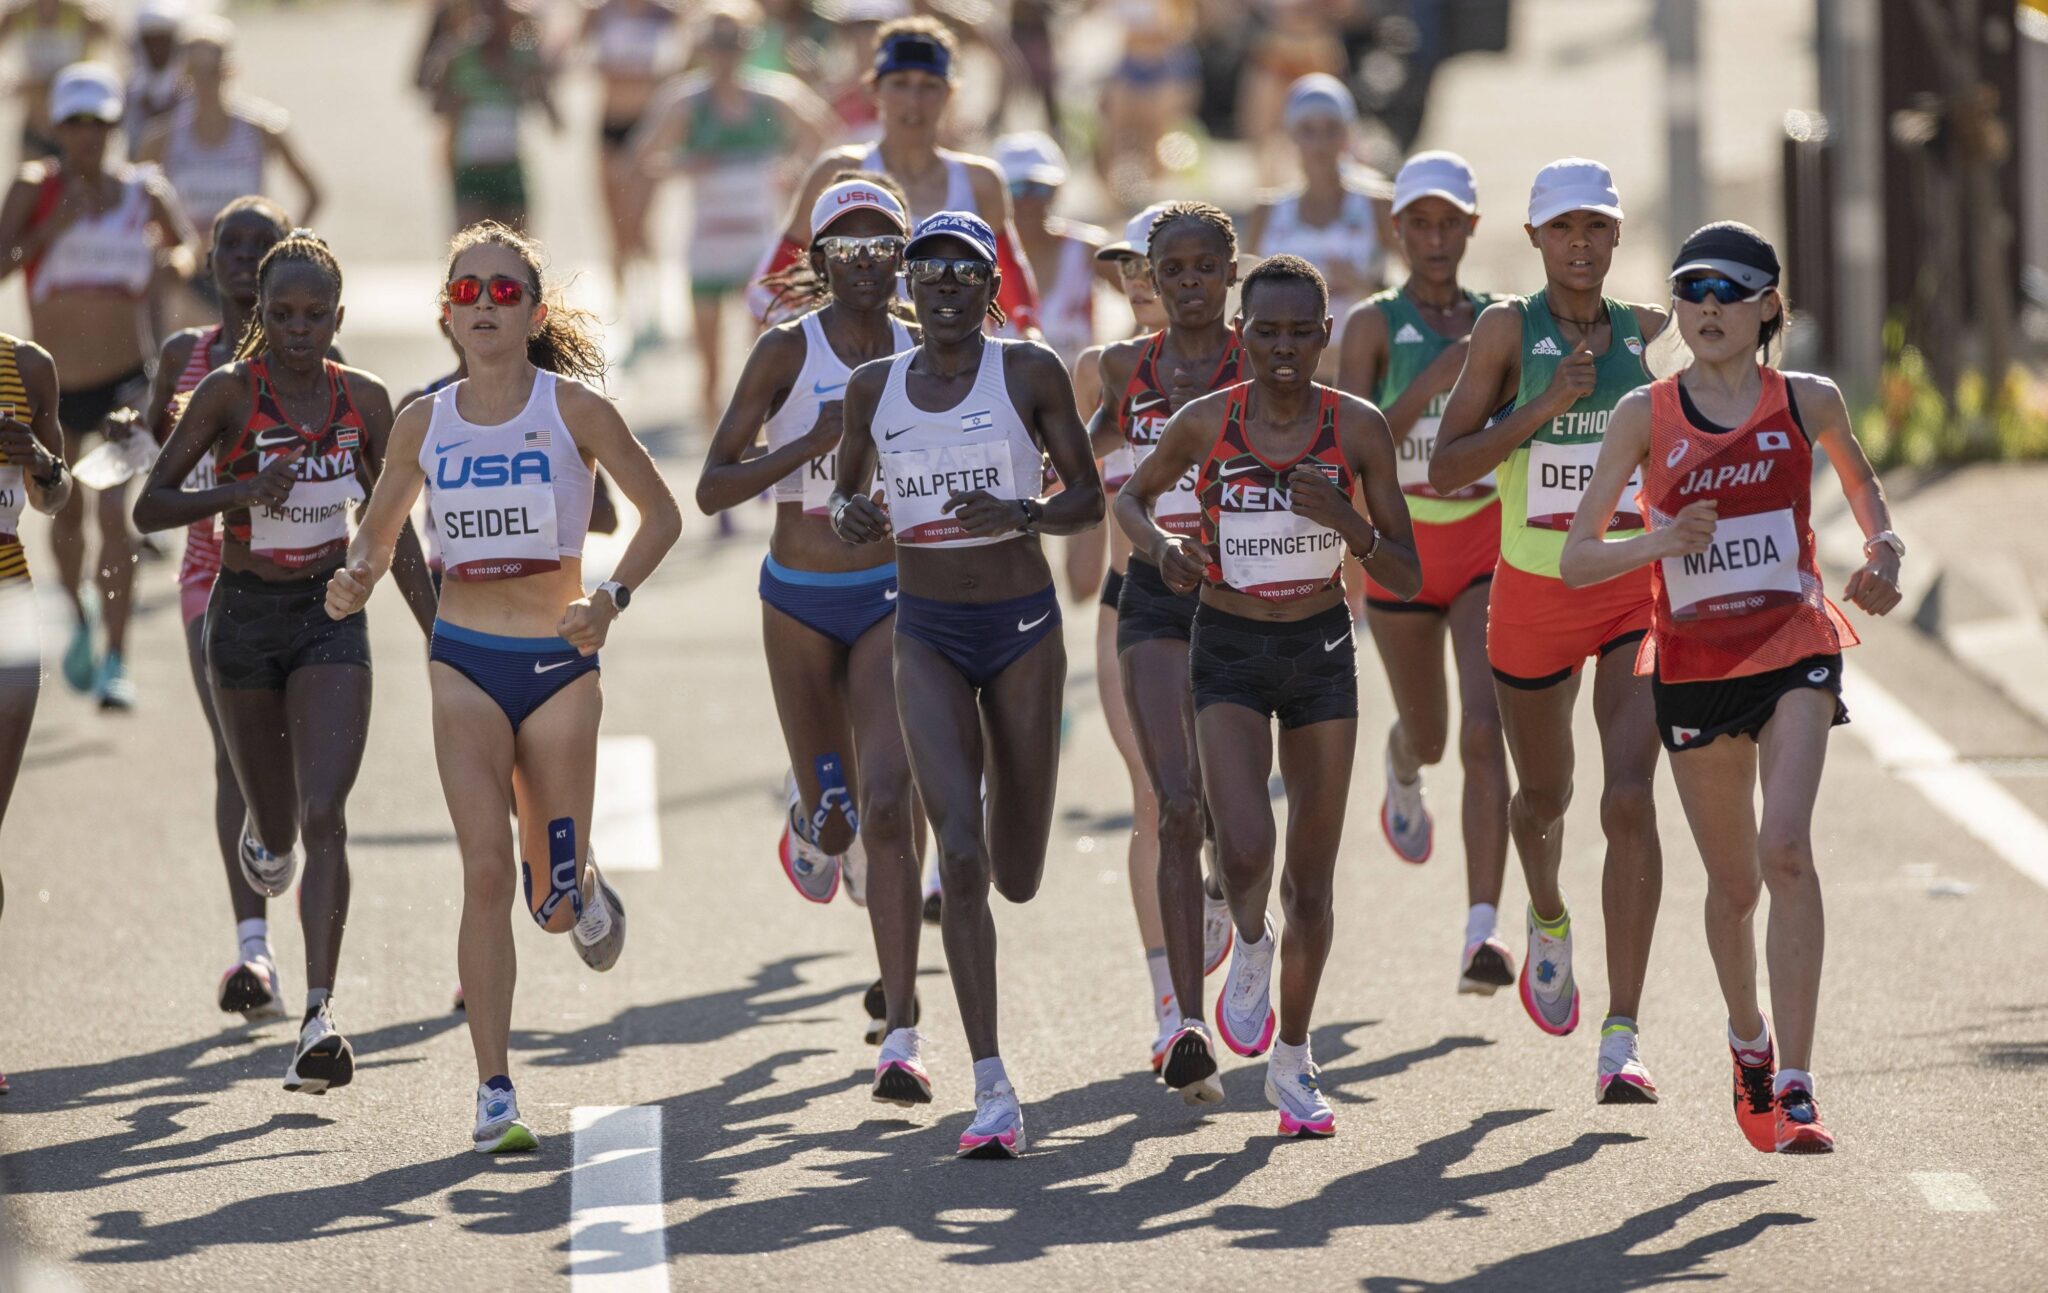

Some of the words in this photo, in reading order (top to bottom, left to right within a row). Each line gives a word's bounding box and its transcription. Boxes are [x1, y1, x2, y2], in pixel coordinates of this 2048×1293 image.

[837, 191, 880, 205] USA
[921, 217, 980, 236] ISRAEL
[1532, 347, 1562, 356] adidas
[1552, 410, 1614, 436] ETHIO
[436, 450, 551, 490] USA
[1680, 459, 1775, 495] JAPAN
[895, 467, 1001, 498] SALPETER
[444, 506, 539, 539] SEIDEL
[924, 528, 943, 537] TOKYO
[944, 526, 959, 535] 2020
[1226, 531, 1341, 557] CHEPNGETICH
[285, 553, 304, 562] TOKYO
[1684, 534, 1780, 576] MAEDA
[466, 567, 486, 575] TOKYO
[486, 566, 501, 574] 2020
[1259, 589, 1280, 598] TOKYO
[1280, 587, 1295, 596] 2020
[1708, 602, 1730, 612] TOKYO
[1730, 600, 1746, 610] 2020
[556, 829, 567, 839] KT
